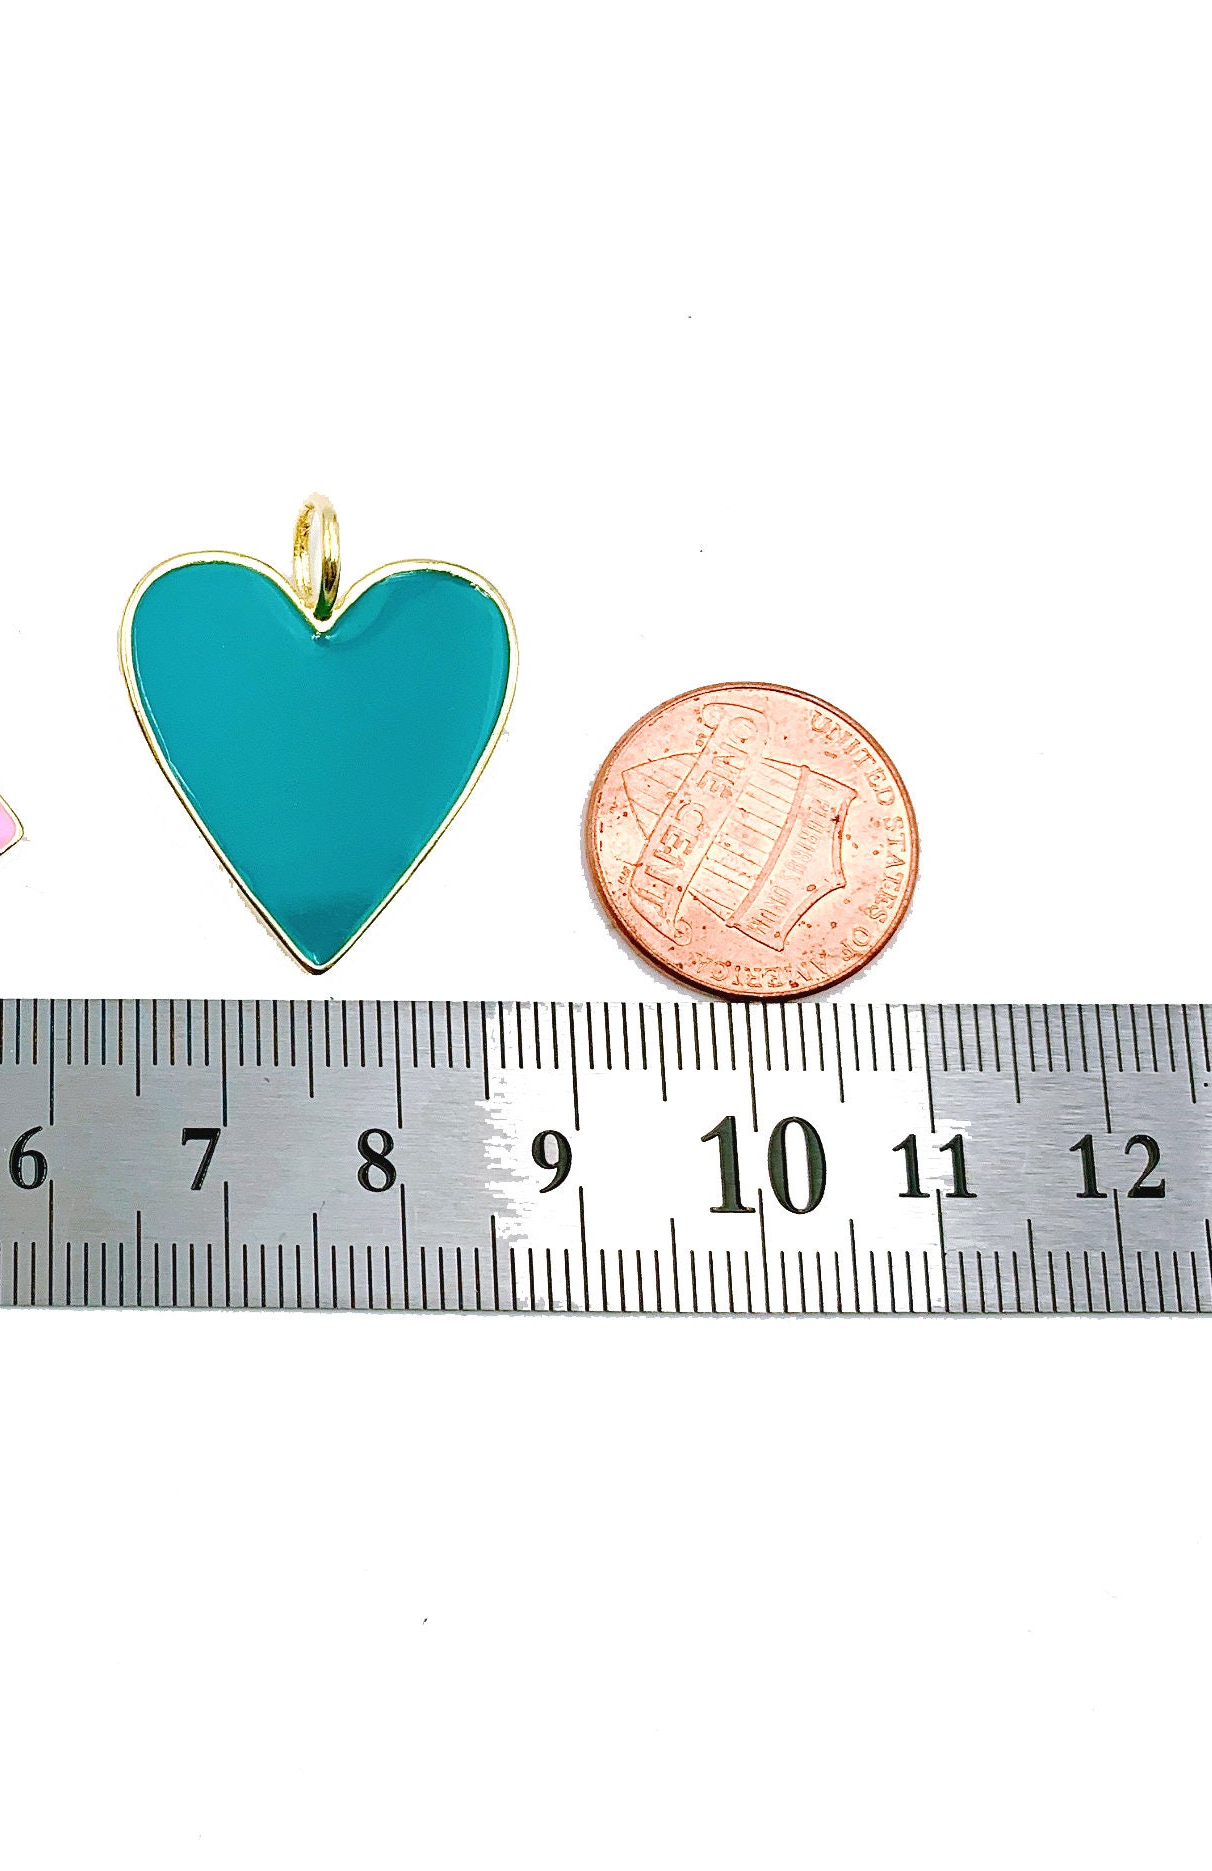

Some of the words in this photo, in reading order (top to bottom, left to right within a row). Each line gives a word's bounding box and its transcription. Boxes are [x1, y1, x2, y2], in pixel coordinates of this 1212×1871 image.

[697, 716, 758, 799] ONE
[810, 710, 896, 806] UNITED
[637, 803, 705, 919] CENT
[865, 814, 906, 924] STATES
[841, 926, 871, 962] OF
[8, 1125, 48, 1190] 6
[181, 1127, 222, 1191] 7
[357, 1128, 397, 1193] 8
[531, 1129, 573, 1194] 9
[700, 1115, 827, 1215] 10
[892, 1133, 977, 1199] 11
[1068, 1134, 1166, 1199] 12
